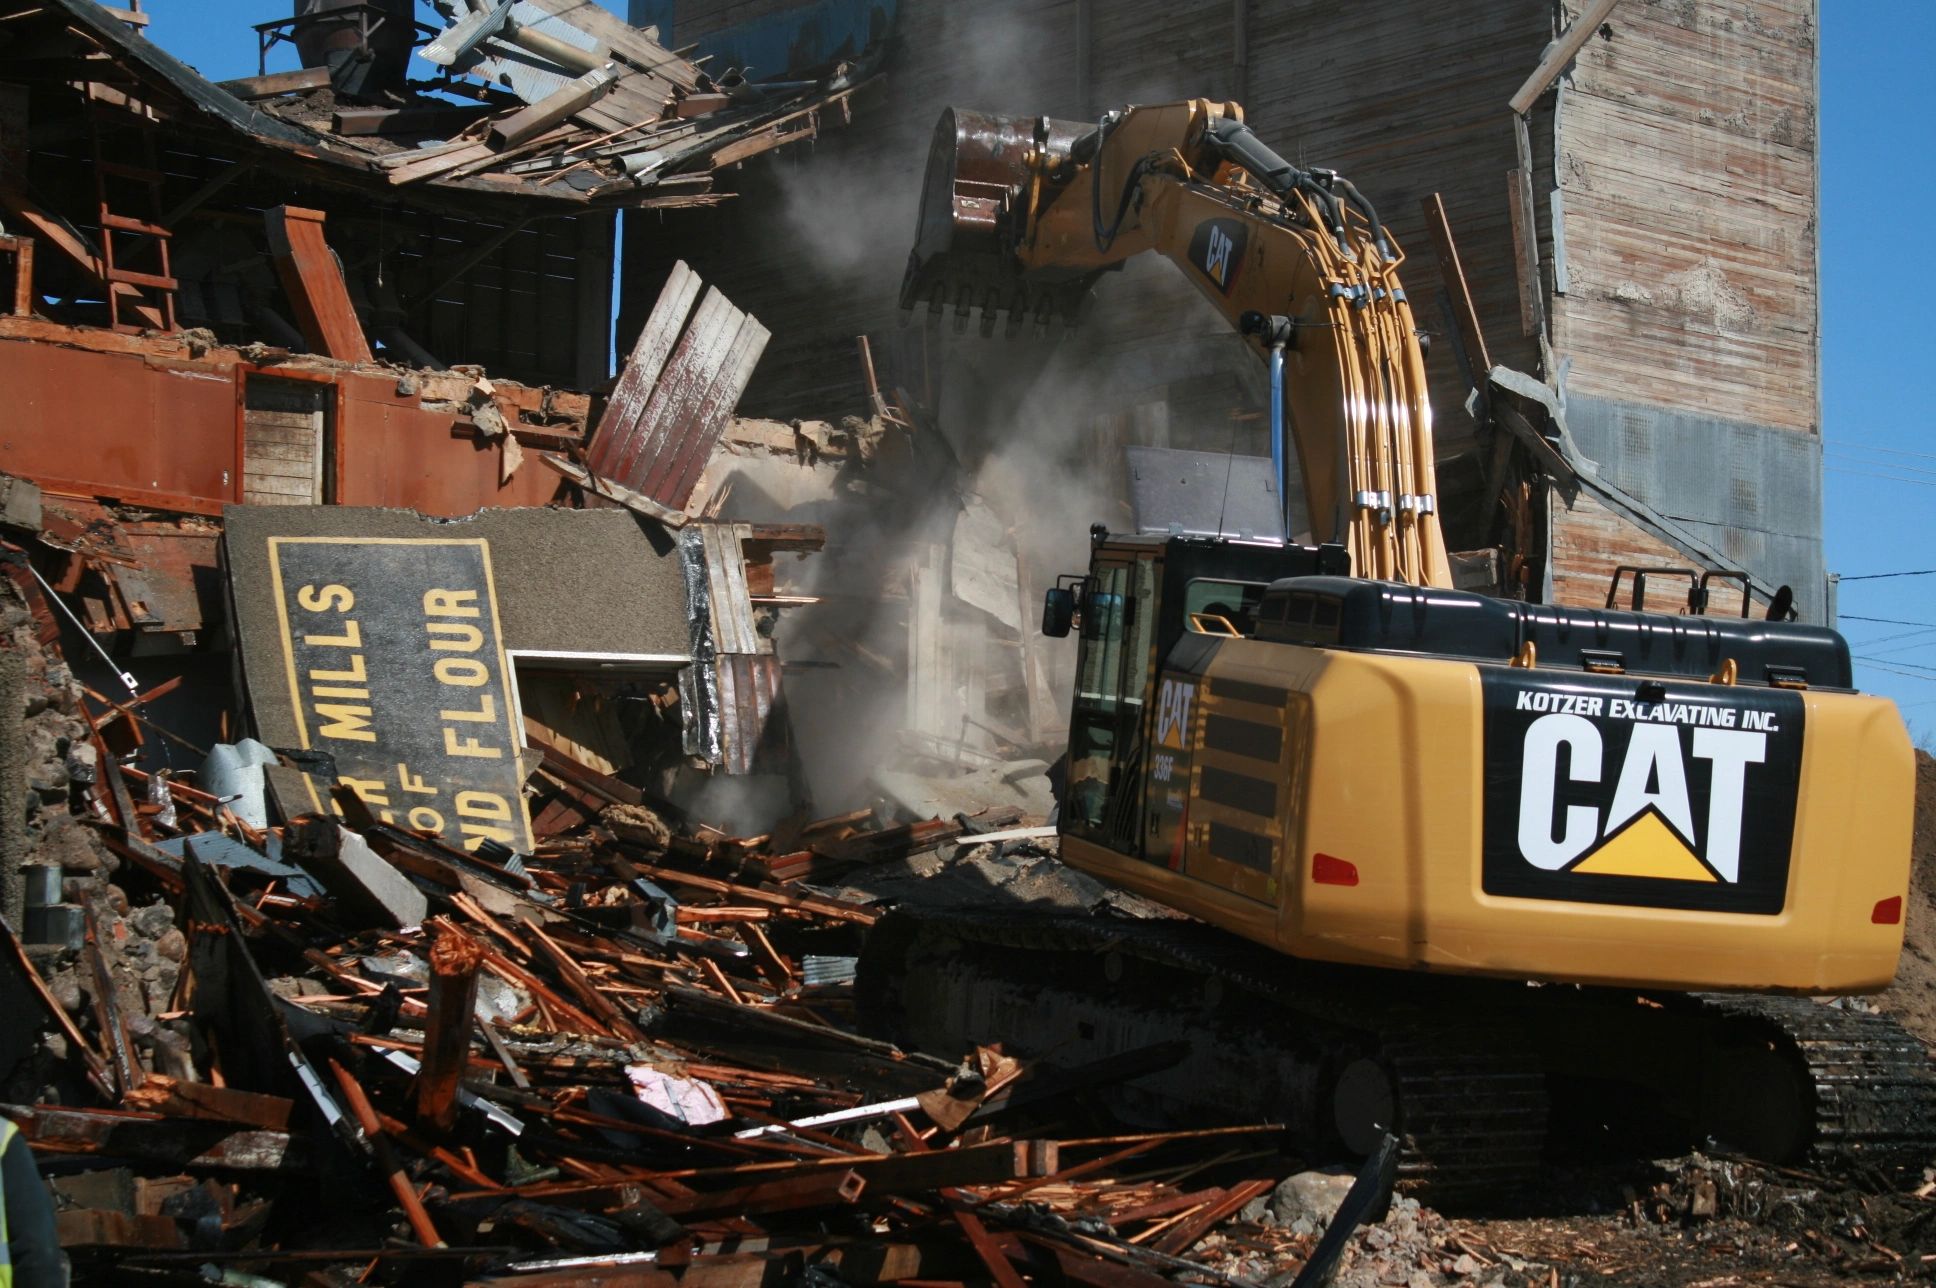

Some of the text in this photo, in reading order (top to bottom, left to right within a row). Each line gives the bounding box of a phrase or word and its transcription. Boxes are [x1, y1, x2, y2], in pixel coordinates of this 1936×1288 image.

[1206, 224, 1233, 287] CAT
[297, 583, 377, 743] MILLS
[422, 587, 503, 759] FLOUR
[1157, 679, 1195, 750] CAT
[1516, 690, 1779, 732] KOTZER EXCAVATING INC.
[397, 762, 445, 838] OF
[1517, 713, 1766, 884] CAT
